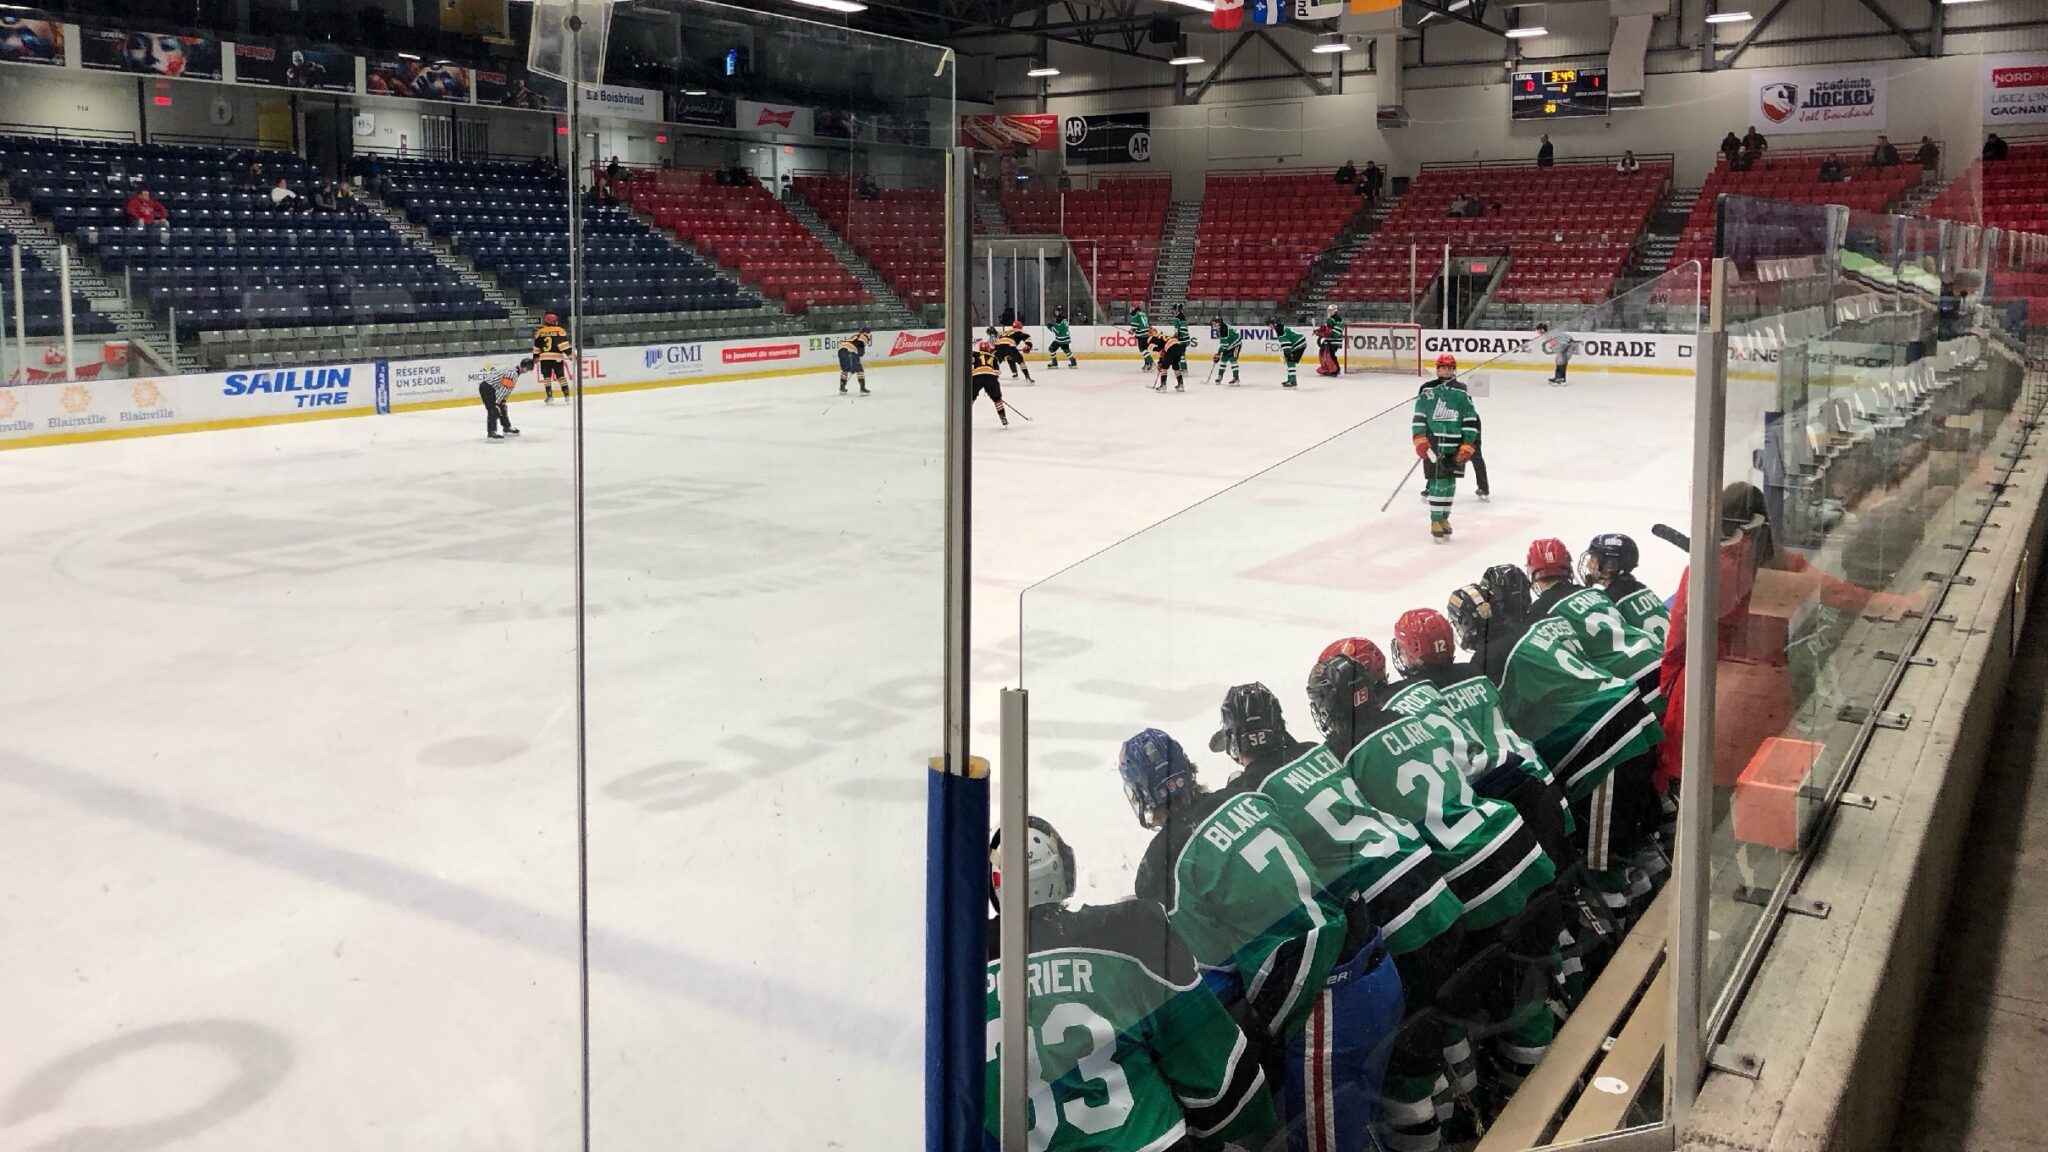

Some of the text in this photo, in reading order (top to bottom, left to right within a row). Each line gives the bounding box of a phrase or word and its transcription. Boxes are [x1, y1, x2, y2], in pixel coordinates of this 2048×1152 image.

[1551, 70, 1575, 82] 3:49
[600, 90, 645, 105] Boisbriand
[1066, 120, 1082, 137] AR
[1132, 138, 1149, 154] AR
[543, 336, 553, 352] 3
[1425, 337, 1532, 353] GATORADE
[667, 345, 702, 363] GMI
[223, 368, 351, 396] SAILUN
[396, 379, 410, 388] UN
[295, 391, 349, 408] TIRE
[48, 414, 107, 428] Blainville
[120, 409, 174, 422] Blainville
[1434, 640, 1447, 653] 12
[1249, 732, 1267, 747] 52
[1382, 719, 1436, 756] CLARK
[1203, 796, 1270, 853] BLAKE
[1238, 827, 1327, 928] 7
